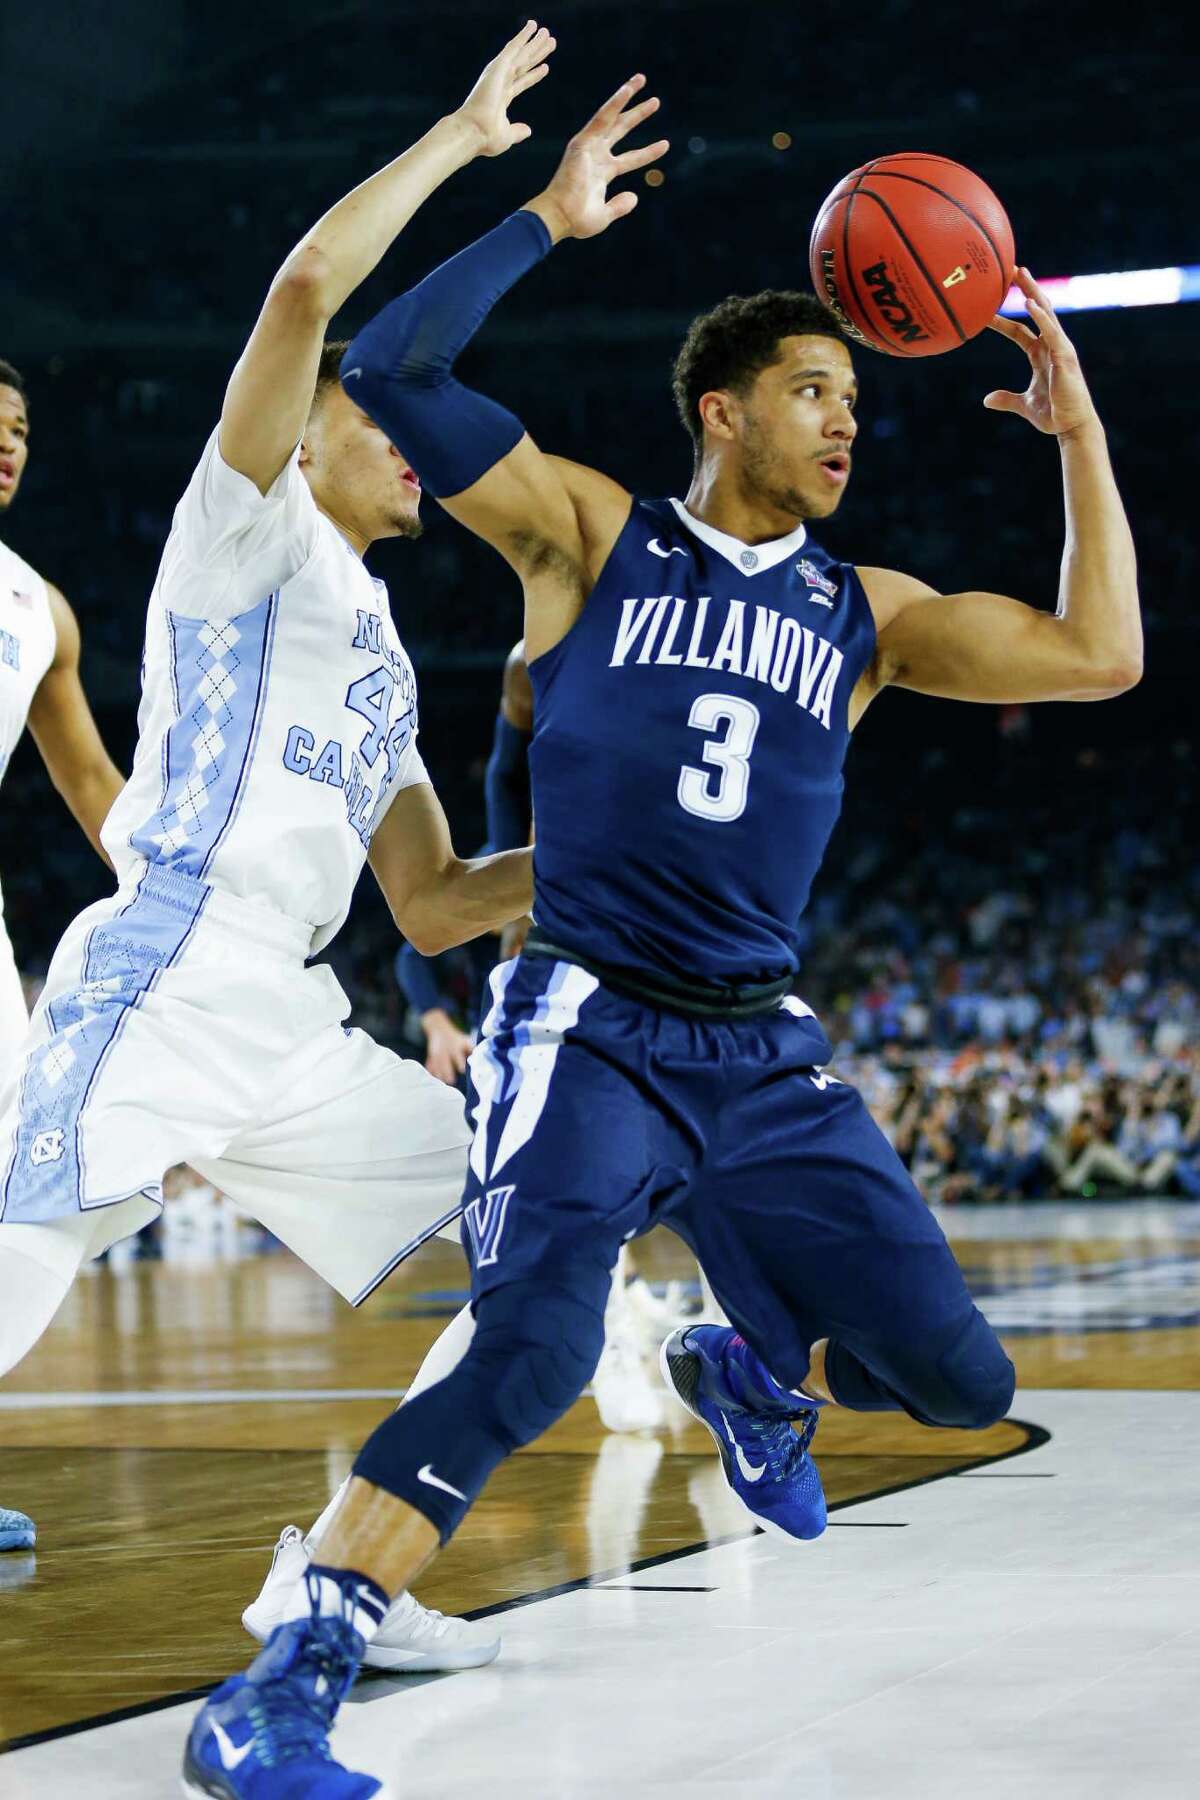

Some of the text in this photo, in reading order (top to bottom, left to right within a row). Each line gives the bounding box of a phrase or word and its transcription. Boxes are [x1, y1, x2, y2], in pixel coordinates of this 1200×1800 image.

[861, 261, 929, 342] NCAA
[608, 596, 844, 730] VILLANOVA
[677, 693, 760, 823] 3
